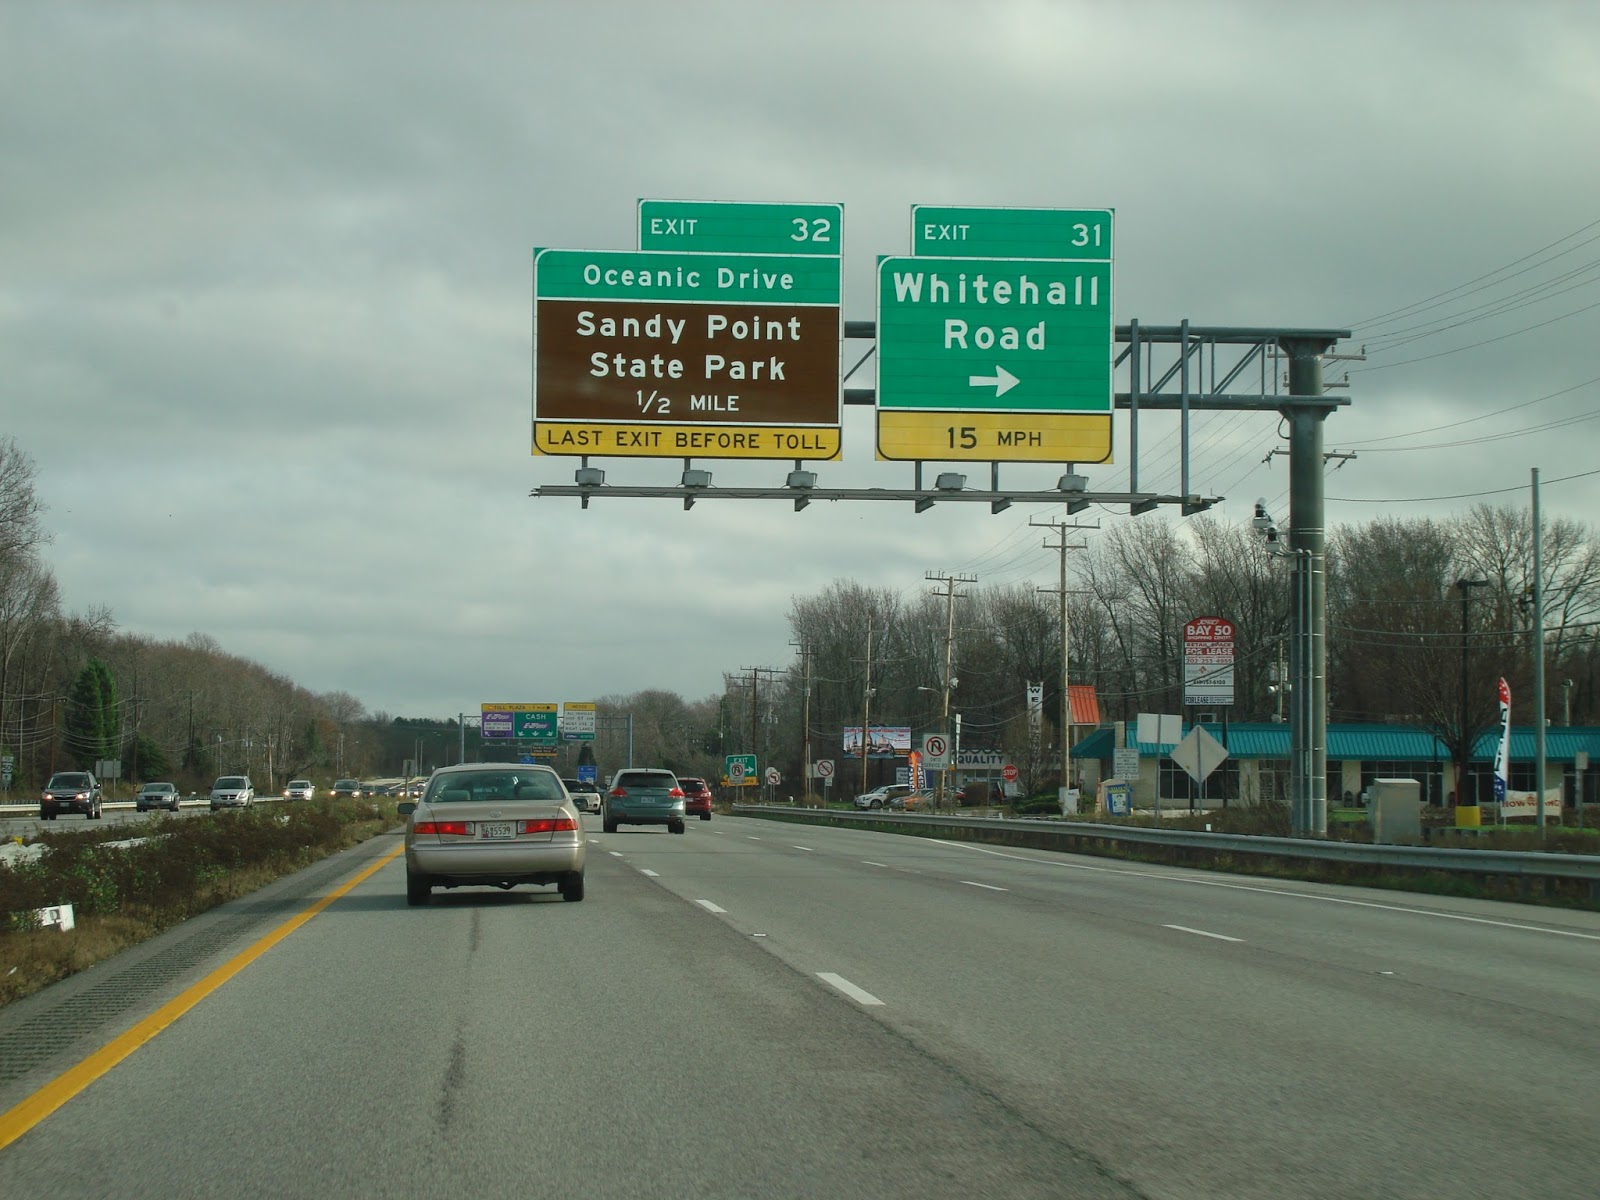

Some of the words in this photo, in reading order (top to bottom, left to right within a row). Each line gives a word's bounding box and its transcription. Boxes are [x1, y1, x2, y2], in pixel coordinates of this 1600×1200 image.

[651, 218, 698, 235] EXIT
[790, 218, 831, 242] 32
[924, 224, 970, 240] EXIT
[1071, 223, 1101, 247] 31
[583, 264, 700, 288] Oceanic
[717, 268, 794, 290] Drive
[893, 272, 1098, 306] Whitehall
[576, 311, 686, 344] Sandy
[707, 314, 801, 341] Point
[944, 318, 1046, 351] Road
[590, 352, 684, 379] State
[705, 354, 785, 381] Park
[636, 390, 671, 414] 1/2
[690, 395, 740, 411] MILE
[547, 430, 603, 446] LAST
[616, 431, 662, 447] EXIT
[675, 432, 760, 448] BEFORE
[773, 434, 827, 449] TOLL
[947, 427, 978, 449] 15
[997, 431, 1042, 447] MPH
[1187, 625, 1212, 635] BAY
[1214, 625, 1232, 635] 50
[958, 755, 1004, 764] QUALITY
